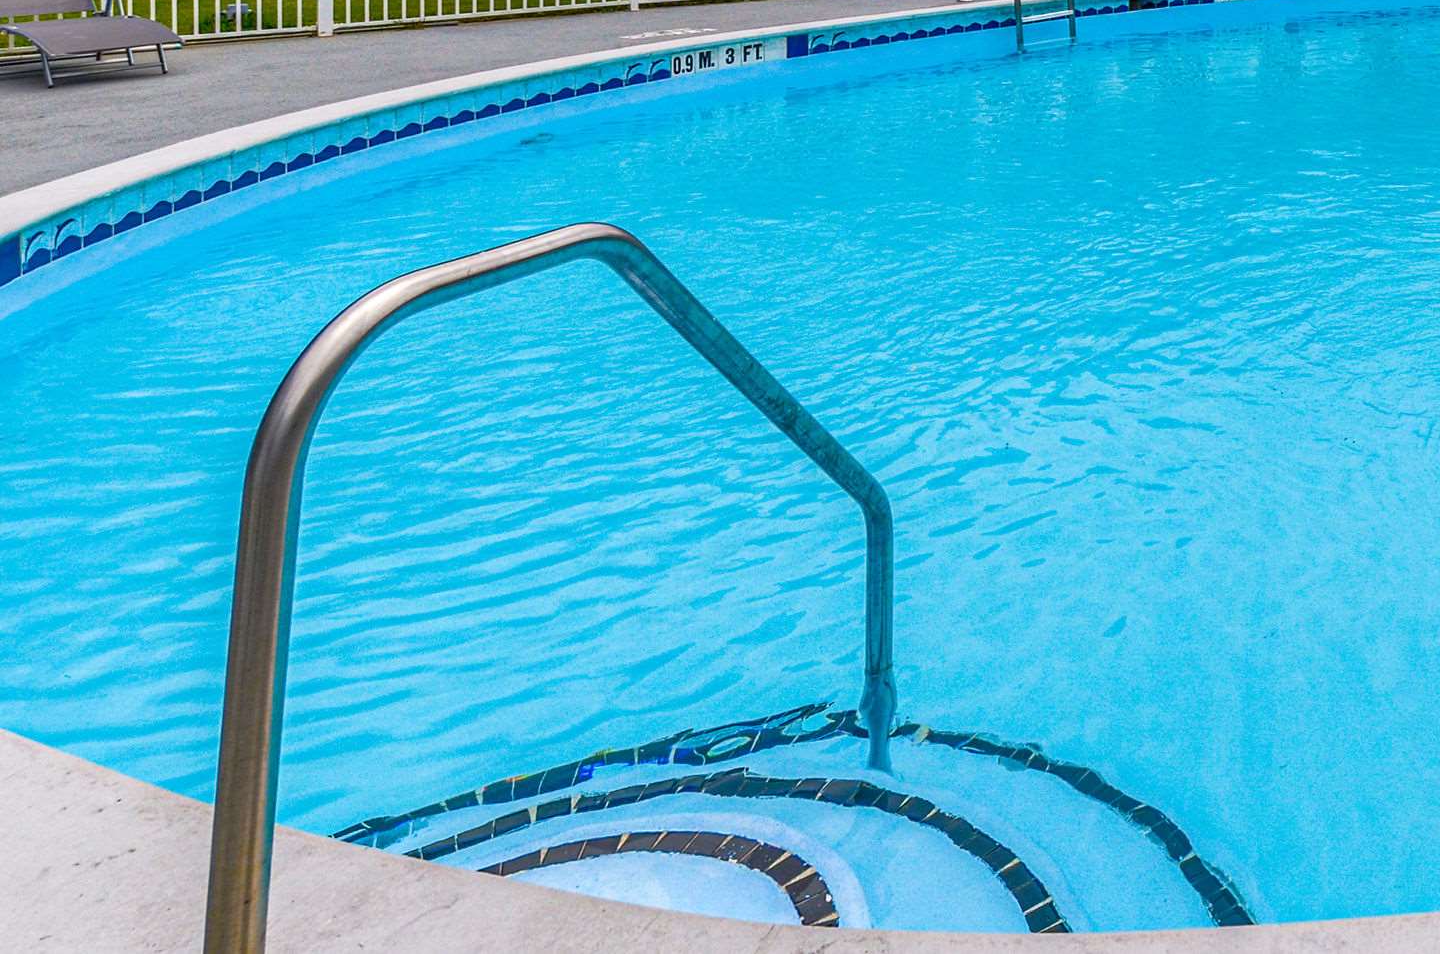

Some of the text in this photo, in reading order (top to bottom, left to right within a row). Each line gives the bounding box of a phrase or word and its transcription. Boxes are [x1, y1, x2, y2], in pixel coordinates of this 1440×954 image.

[673, 43, 763, 75] 0.9 M. 3 FT.
